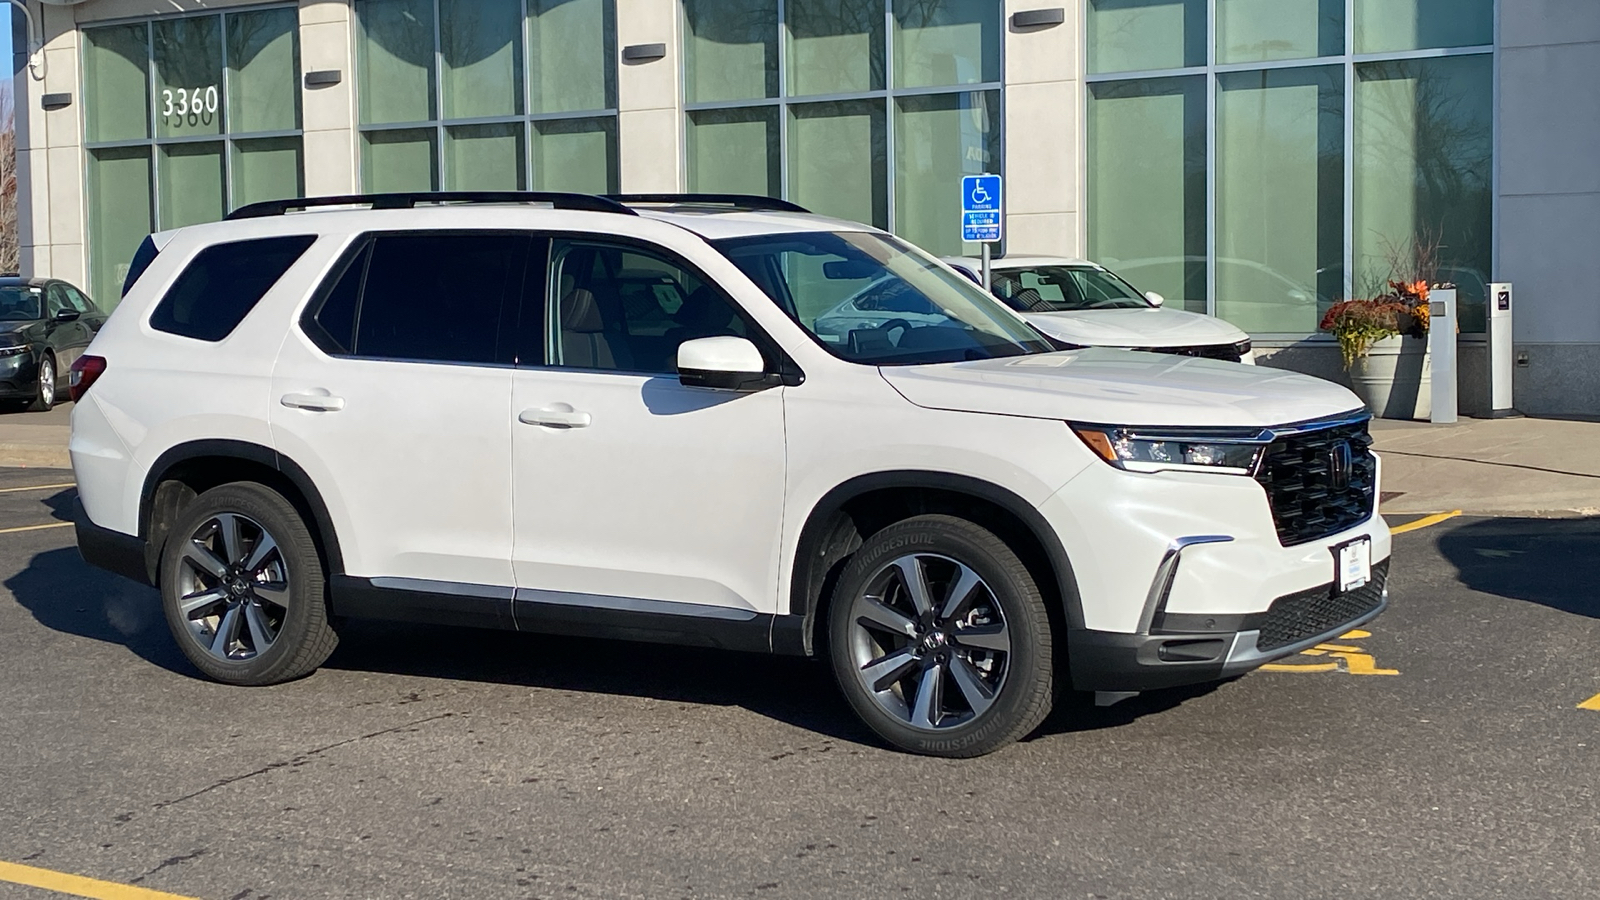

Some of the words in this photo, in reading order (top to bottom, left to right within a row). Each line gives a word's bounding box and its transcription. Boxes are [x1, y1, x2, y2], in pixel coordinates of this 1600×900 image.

[162, 86, 218, 116] 3360
[857, 532, 935, 575] BRIDGESTONE
[919, 712, 1006, 752] BRIDGESTONE
